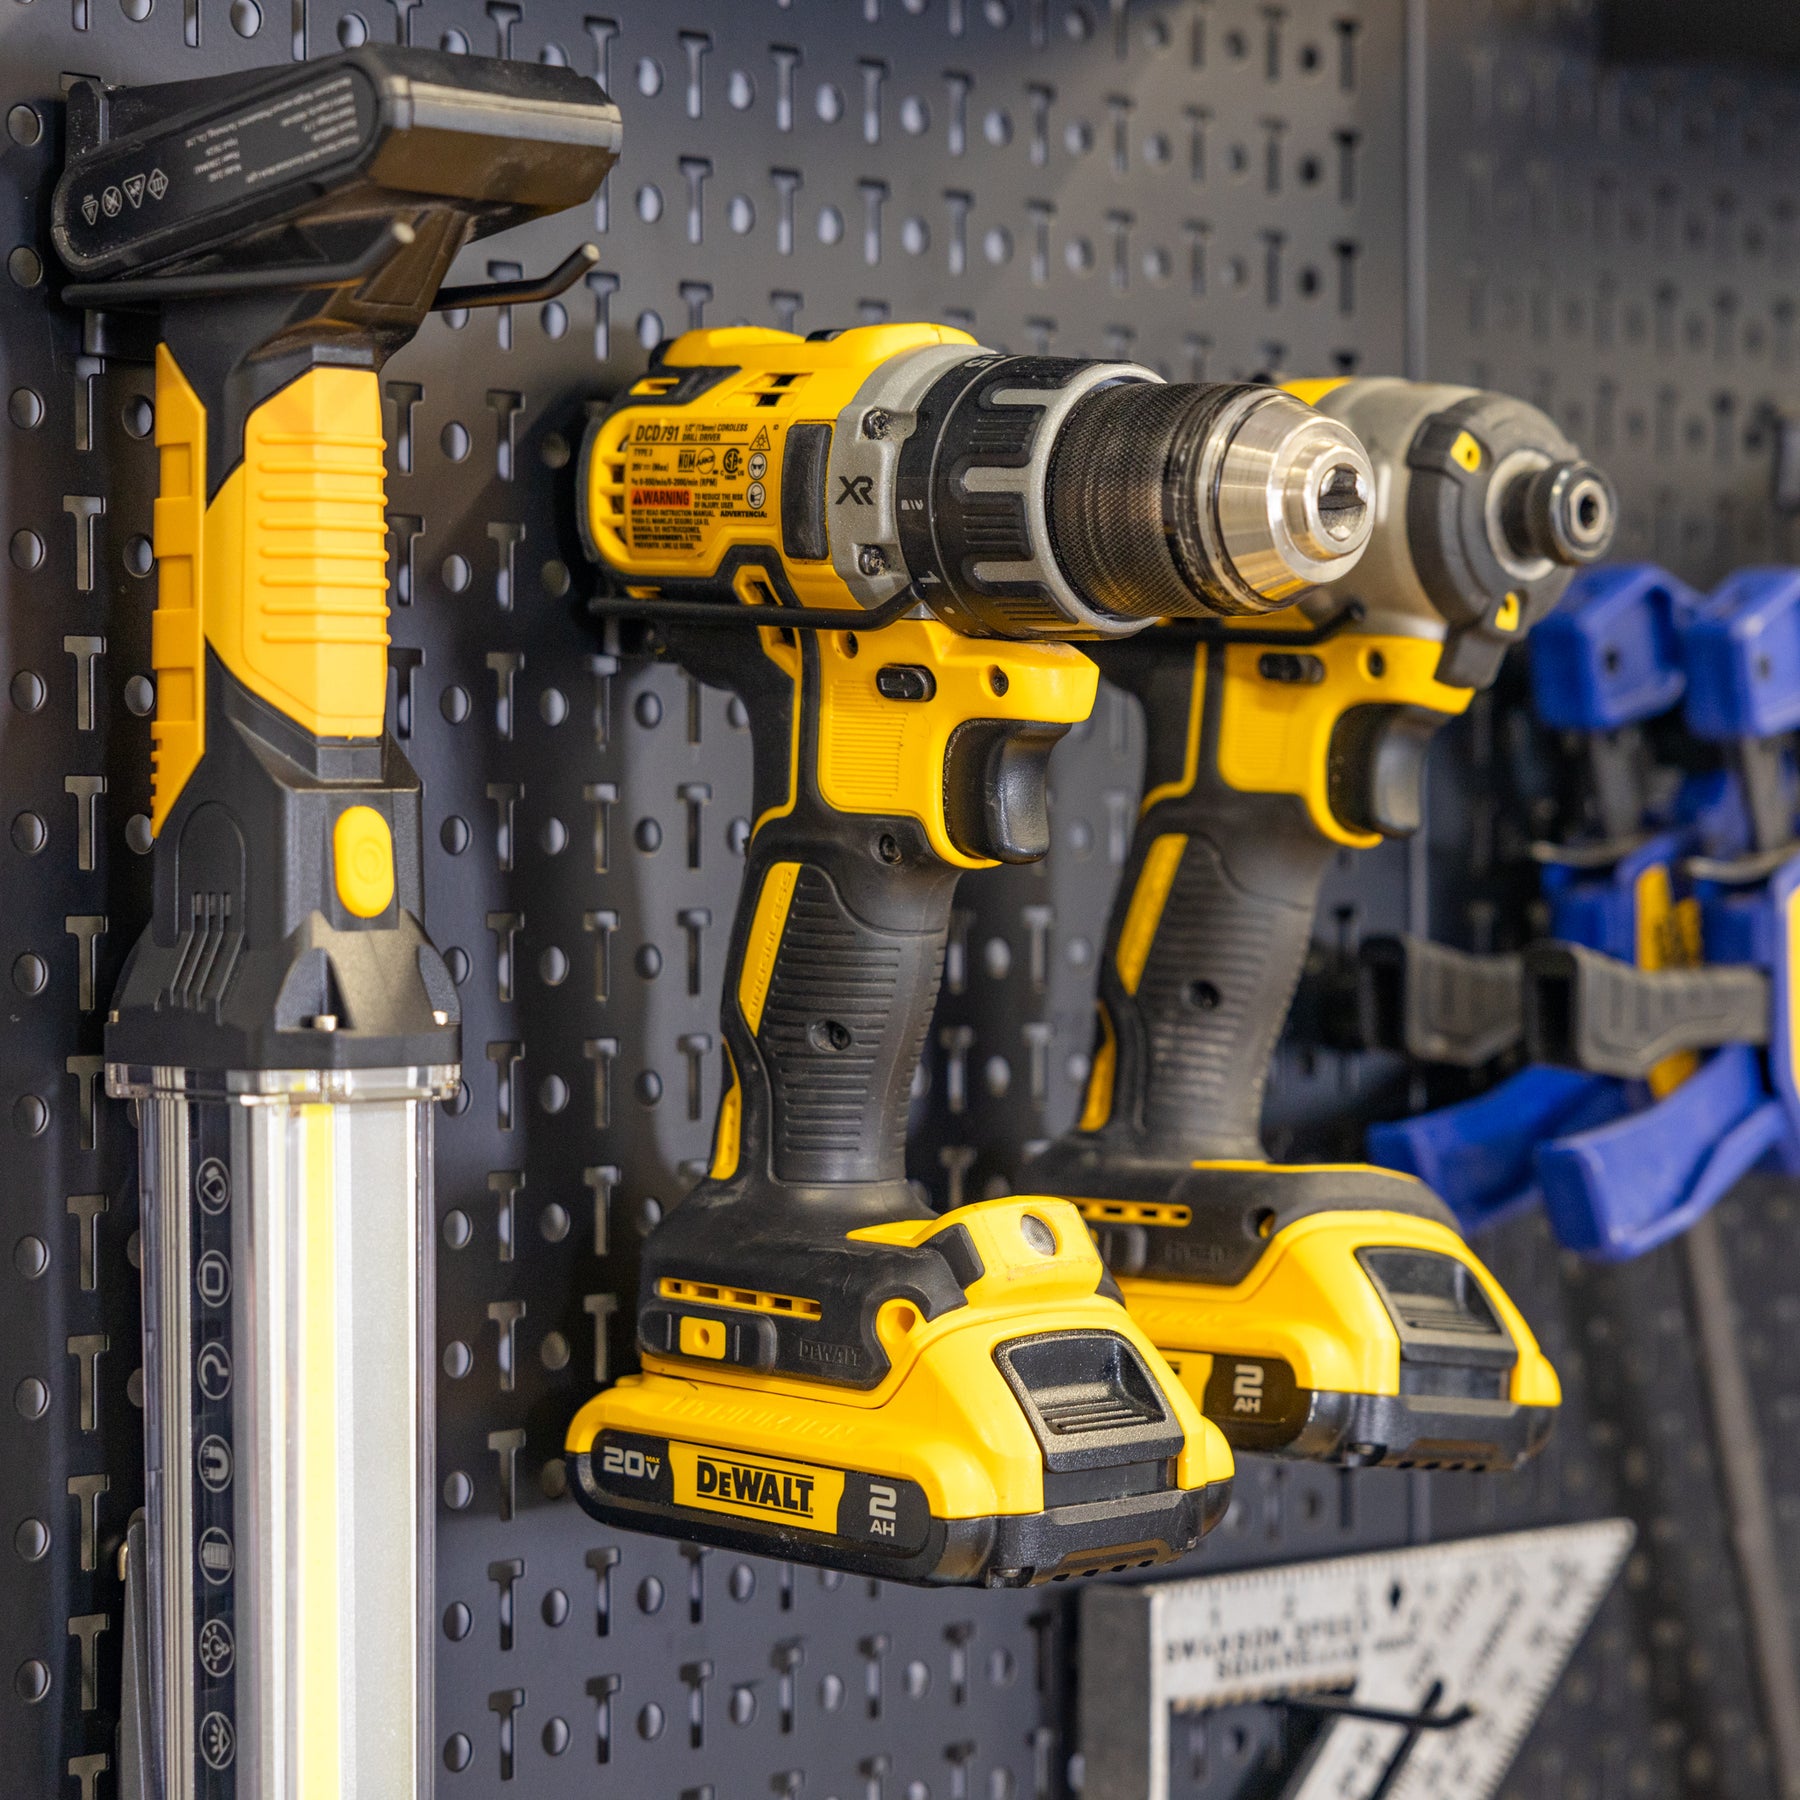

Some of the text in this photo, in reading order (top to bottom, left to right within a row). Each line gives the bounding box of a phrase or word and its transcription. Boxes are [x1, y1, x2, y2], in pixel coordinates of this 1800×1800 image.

[635, 424, 680, 441] DCD791
[717, 424, 748, 432] CORDLESS
[699, 433, 721, 442] DRIVER
[678, 453, 696, 469] NOM
[642, 490, 690, 506] WARNING
[835, 475, 874, 505] XR
[720, 510, 768, 518] ADVERTENCIA:
[1232, 1364, 1264, 1397] 2
[1233, 1396, 1261, 1414] AH
[869, 1484, 897, 1521] 2
[870, 1519, 896, 1538] AH
